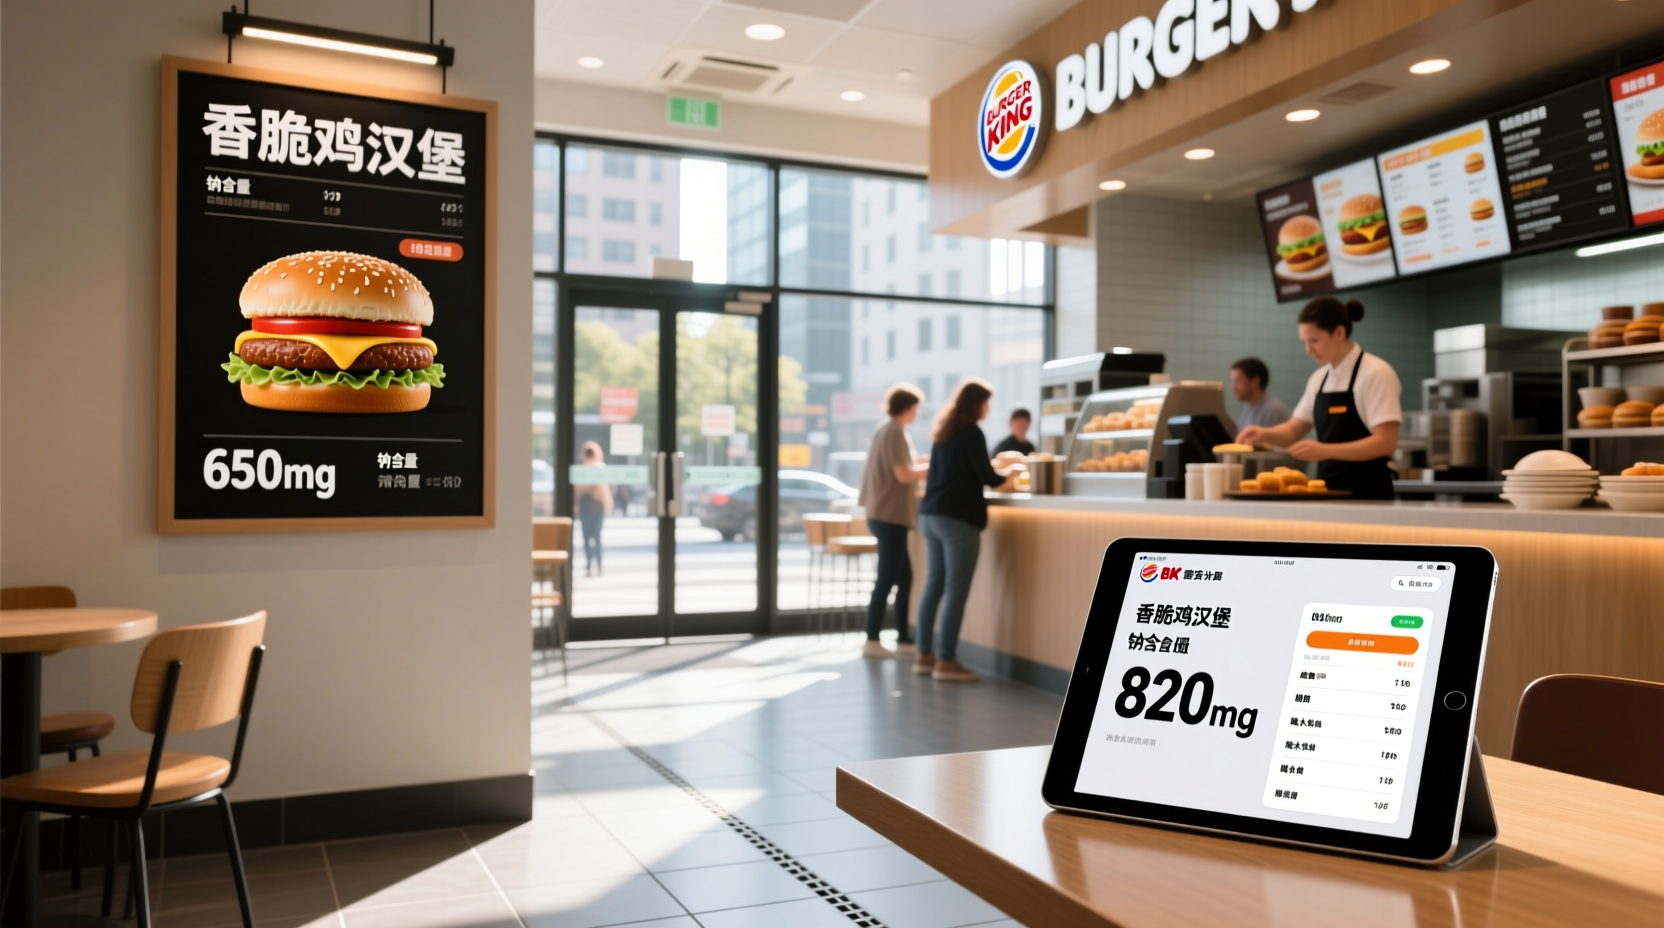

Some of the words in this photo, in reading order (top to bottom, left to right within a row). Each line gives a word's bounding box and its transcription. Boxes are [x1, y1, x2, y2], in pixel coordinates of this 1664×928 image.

[987, 80, 1032, 126] BURGER
[988, 96, 1032, 154] KING
[202, 103, 466, 185] 香脆鸡汉堡
[203, 448, 336, 499] 650mg
[1160, 567, 1182, 581] BK
[1136, 603, 1232, 629] 香脆鸡汉堡
[1115, 666, 1258, 739] 820mg
